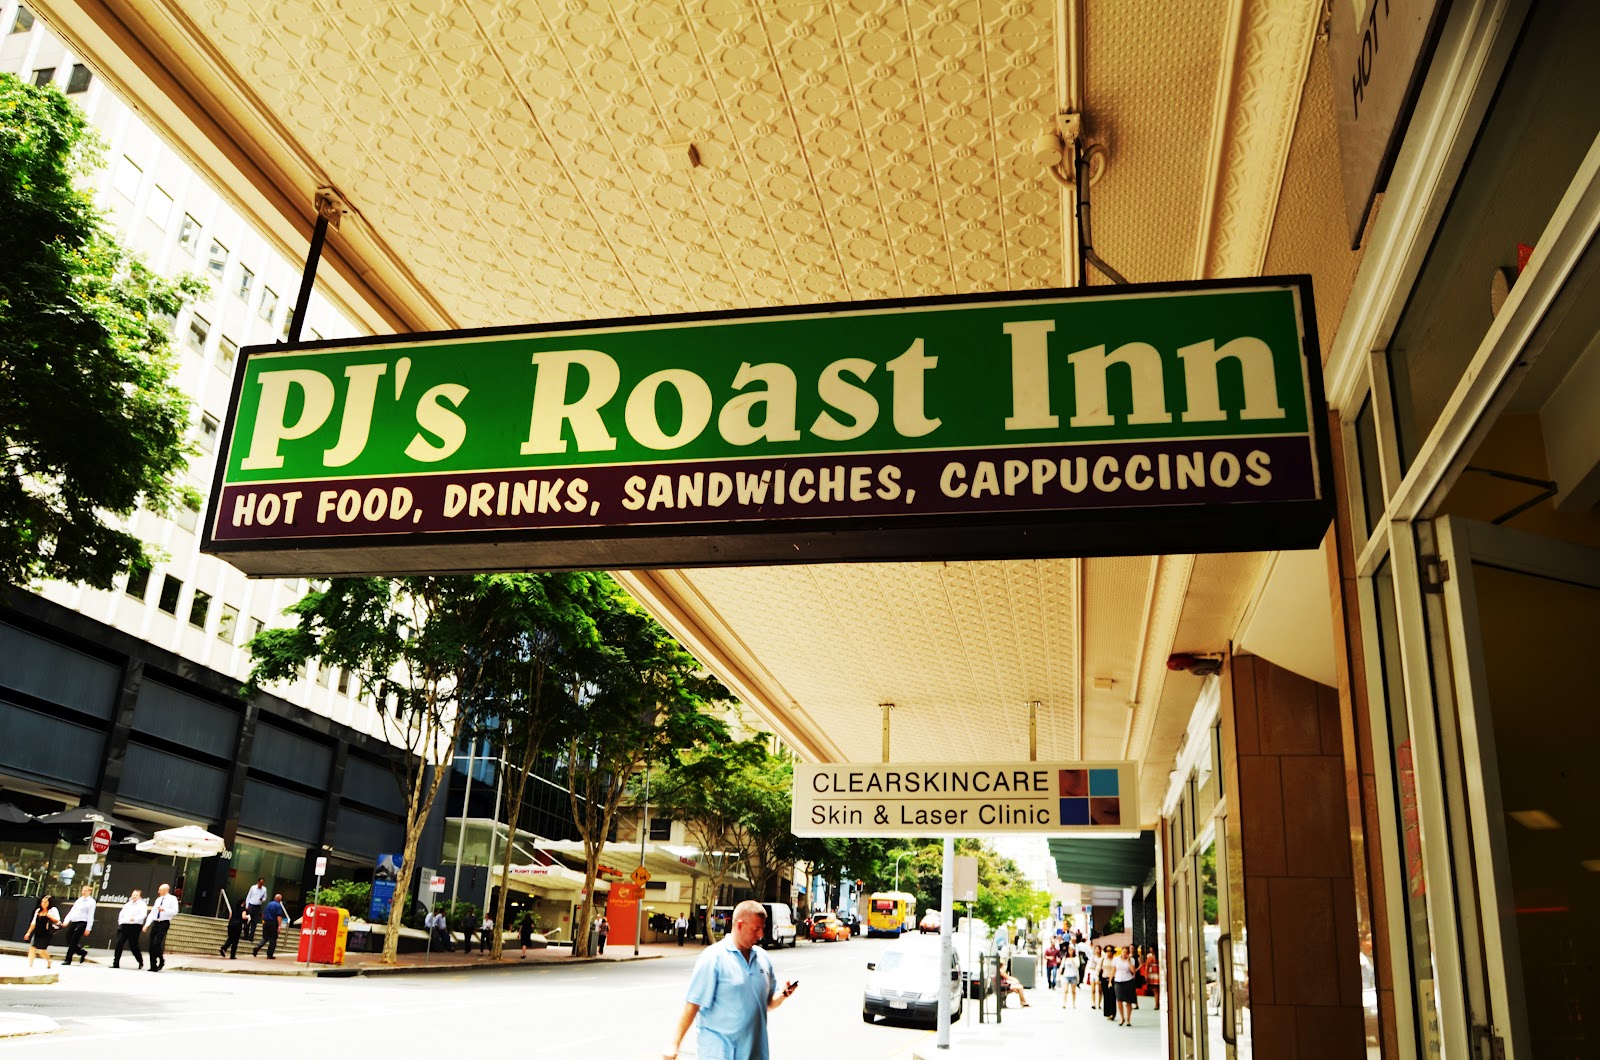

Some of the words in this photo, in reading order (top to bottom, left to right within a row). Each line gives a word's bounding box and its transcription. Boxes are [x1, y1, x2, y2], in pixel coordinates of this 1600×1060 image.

[1352, 0, 1379, 122] HOT
[240, 356, 471, 470] PJ's
[520, 337, 943, 455] Roast
[1003, 319, 1286, 431] Inn
[232, 491, 303, 527] HOT
[316, 485, 423, 524] FOOD,
[443, 477, 600, 518] DRINKS,
[621, 464, 917, 512] SANDWICHES,
[939, 449, 1273, 499] CAPPUCCINOS
[811, 804, 863, 825] Skin
[873, 804, 890, 825] &
[900, 804, 968, 825] Laser
[978, 804, 1050, 825] Clinic
[812, 770, 1050, 792] CLEARSKINCARE
